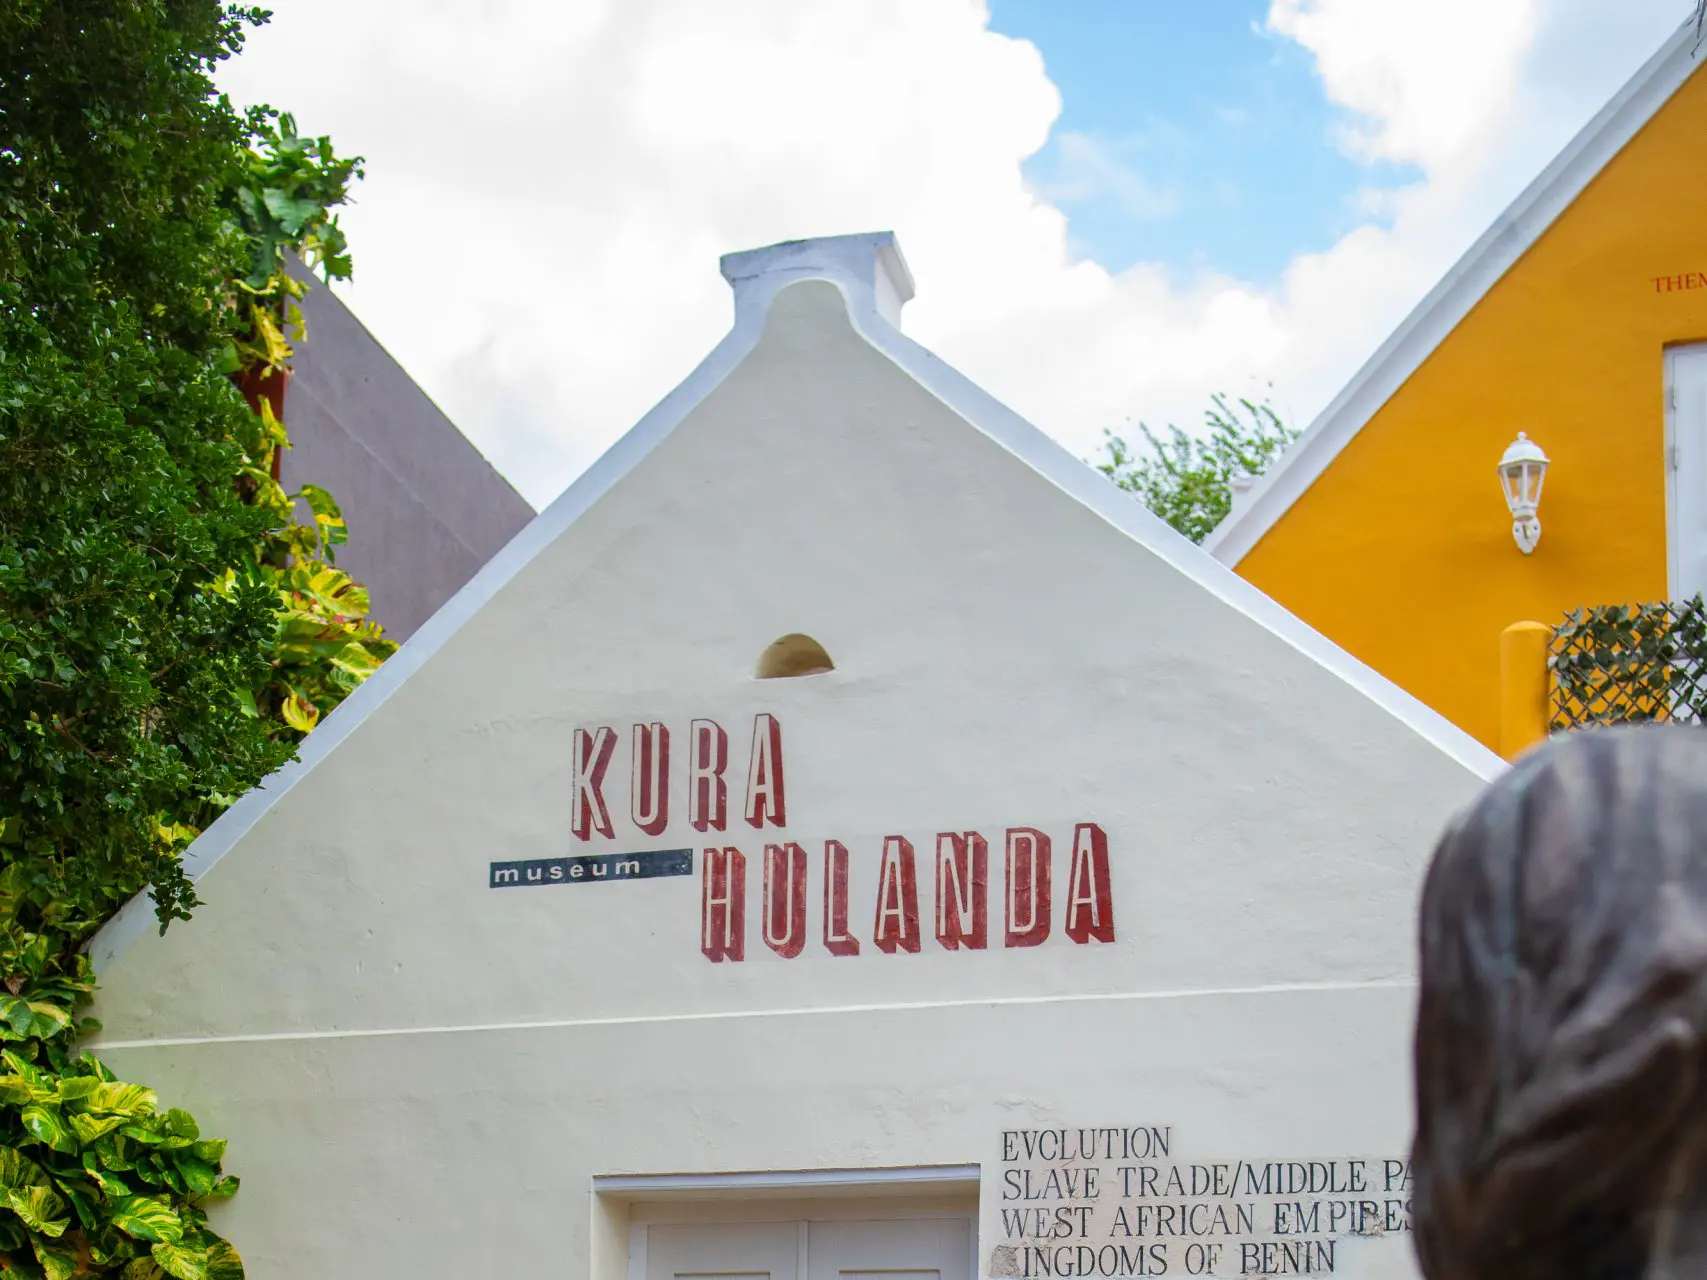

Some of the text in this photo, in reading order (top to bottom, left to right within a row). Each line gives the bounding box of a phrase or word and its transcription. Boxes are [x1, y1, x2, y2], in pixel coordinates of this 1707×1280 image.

[571, 713, 787, 842] KURA
[494, 859, 642, 884] museum
[701, 822, 1115, 964] HULANDA
[1002, 1127, 1172, 1162] EVOLUTION
[1003, 1167, 1100, 1200] SLAVE
[1117, 1160, 1367, 1198] TRADE/MIDDLE
[1001, 1206, 1093, 1239] WEST
[1109, 1203, 1254, 1237] AFRICAN
[1010, 1239, 1337, 1277] INGDOMS OF BENIN
